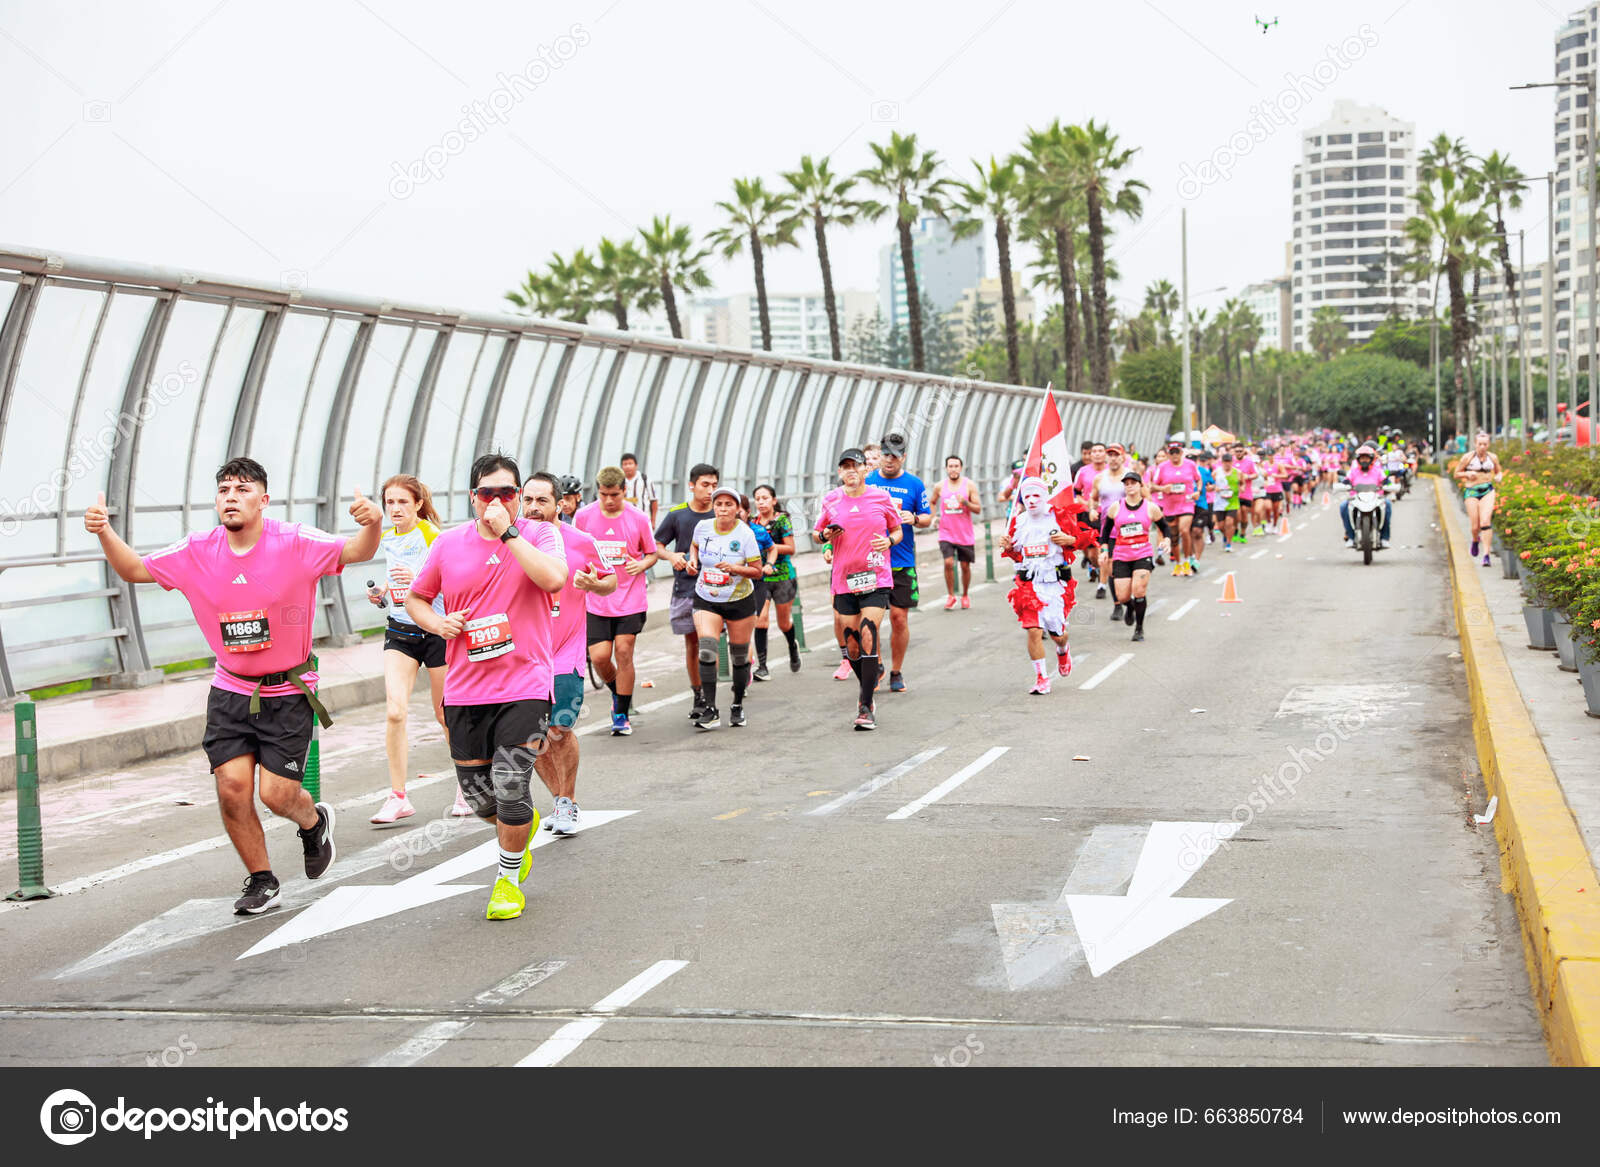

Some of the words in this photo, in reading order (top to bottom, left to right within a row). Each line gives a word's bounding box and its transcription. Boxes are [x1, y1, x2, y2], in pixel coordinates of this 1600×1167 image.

[854, 577, 870, 586] 232
[225, 621, 262, 636] 11868
[468, 626, 500, 645] 7919
